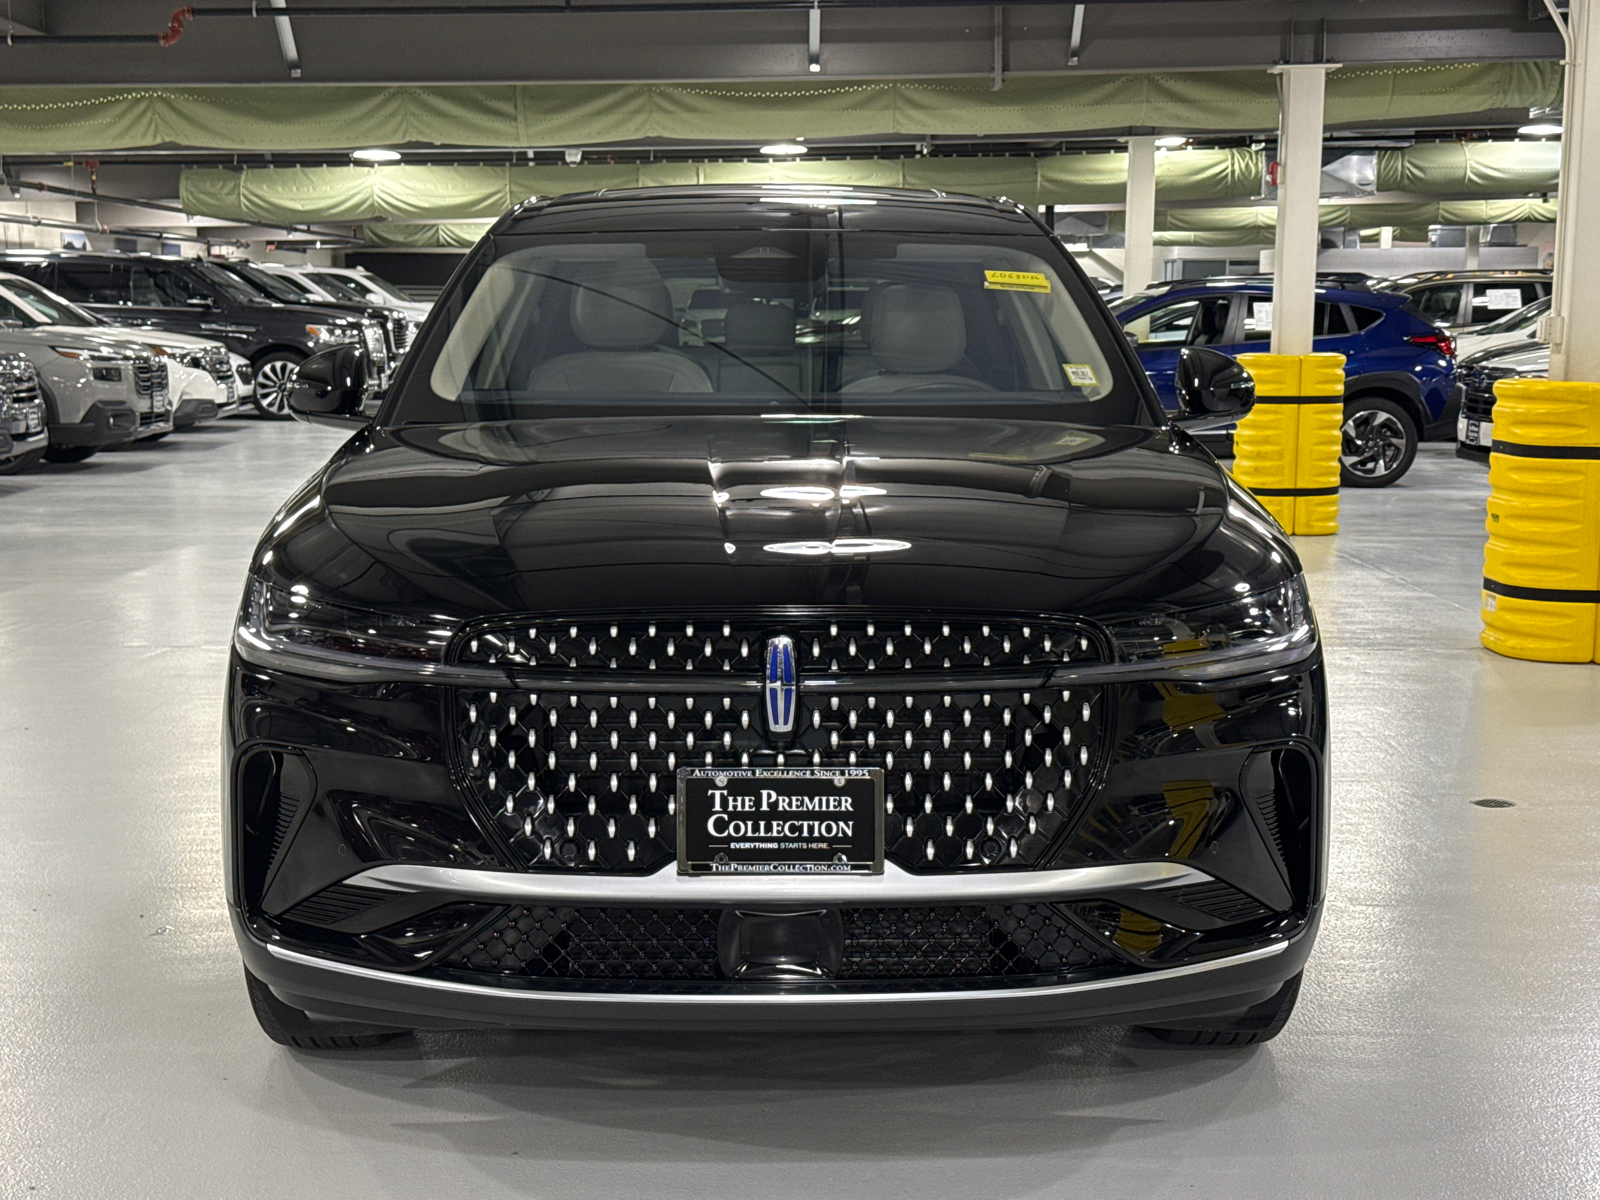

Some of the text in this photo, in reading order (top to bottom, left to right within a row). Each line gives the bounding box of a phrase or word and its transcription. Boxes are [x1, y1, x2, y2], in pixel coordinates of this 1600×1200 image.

[692, 768, 869, 777] AUTOMOTIVE EXCELLENCE SINCE 1995
[707, 789, 854, 812] THE PREMIER
[707, 814, 854, 838] COLLECTION
[710, 863, 851, 872] THEPREMIERCOLLECTION.COM
